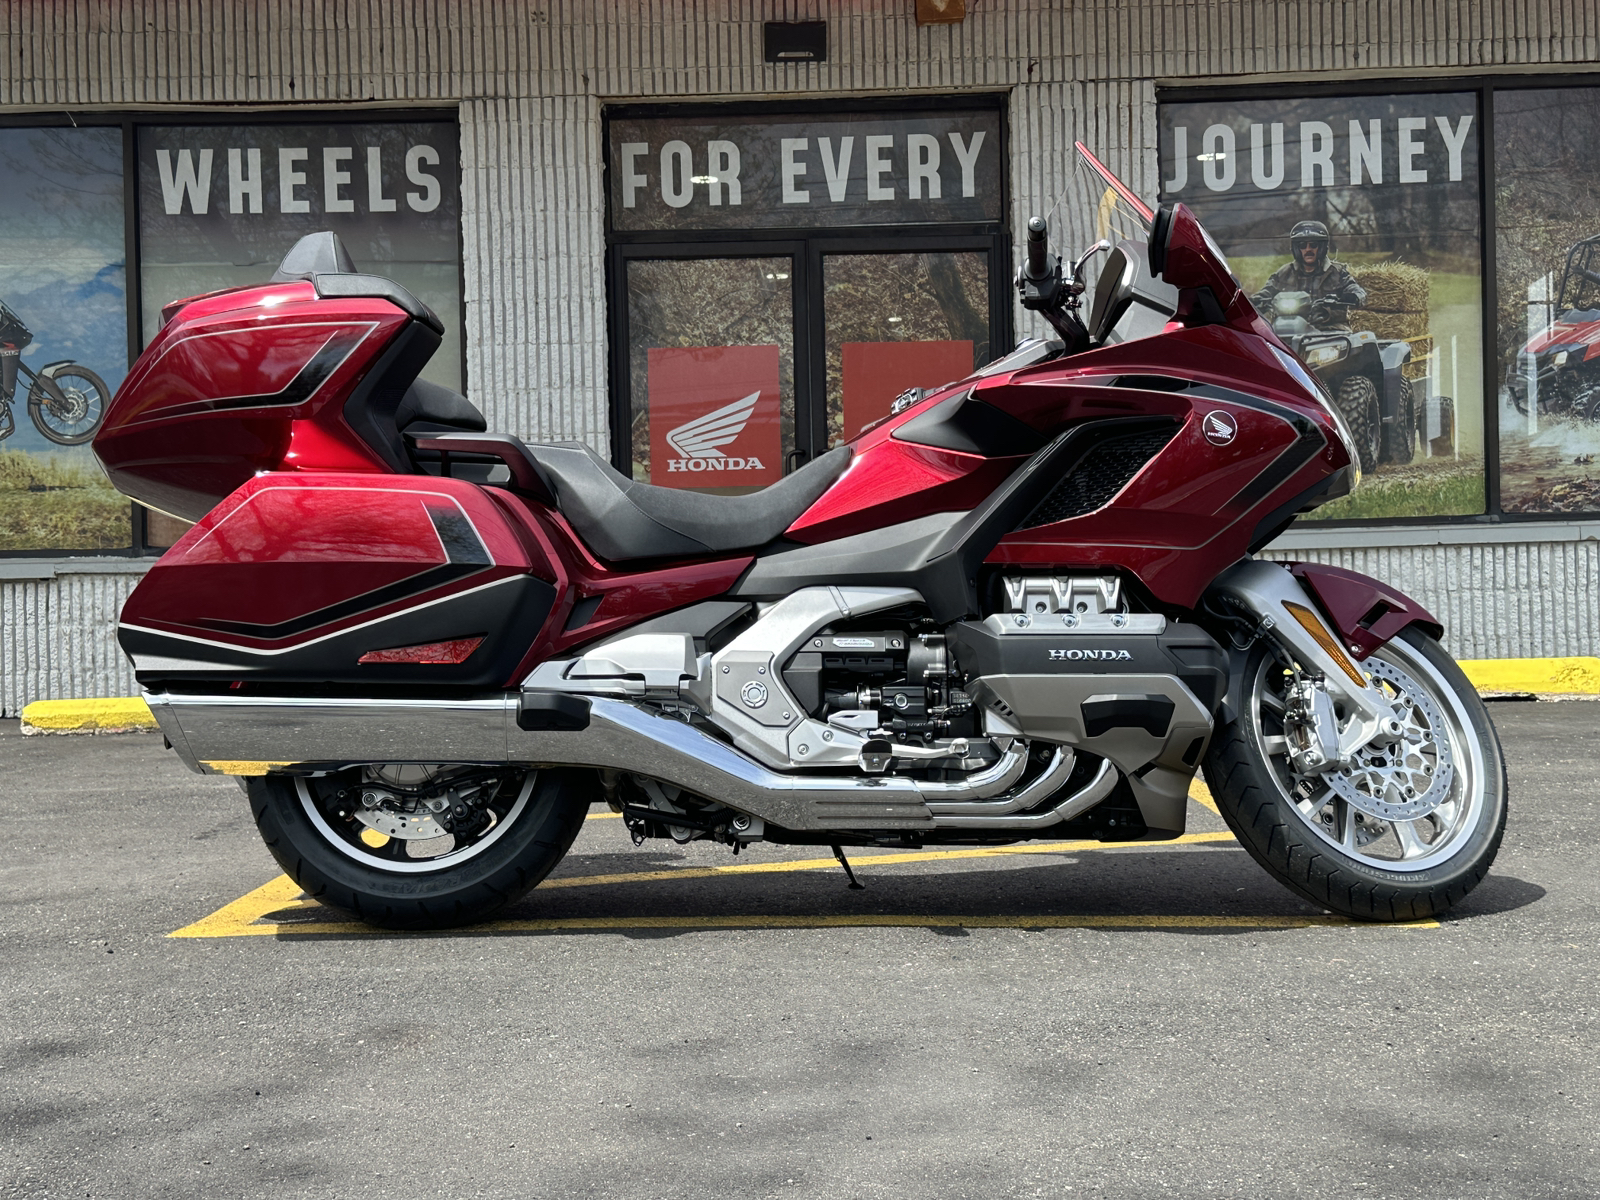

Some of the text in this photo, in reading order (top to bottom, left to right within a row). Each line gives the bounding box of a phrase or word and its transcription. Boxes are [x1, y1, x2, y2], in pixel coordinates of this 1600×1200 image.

[156, 144, 441, 214] WHEELS
[621, 131, 986, 208] FOR EVERY
[1165, 115, 1473, 193] JOURNEY
[667, 457, 766, 472] HONDA
[1048, 649, 1134, 661] HONDA
